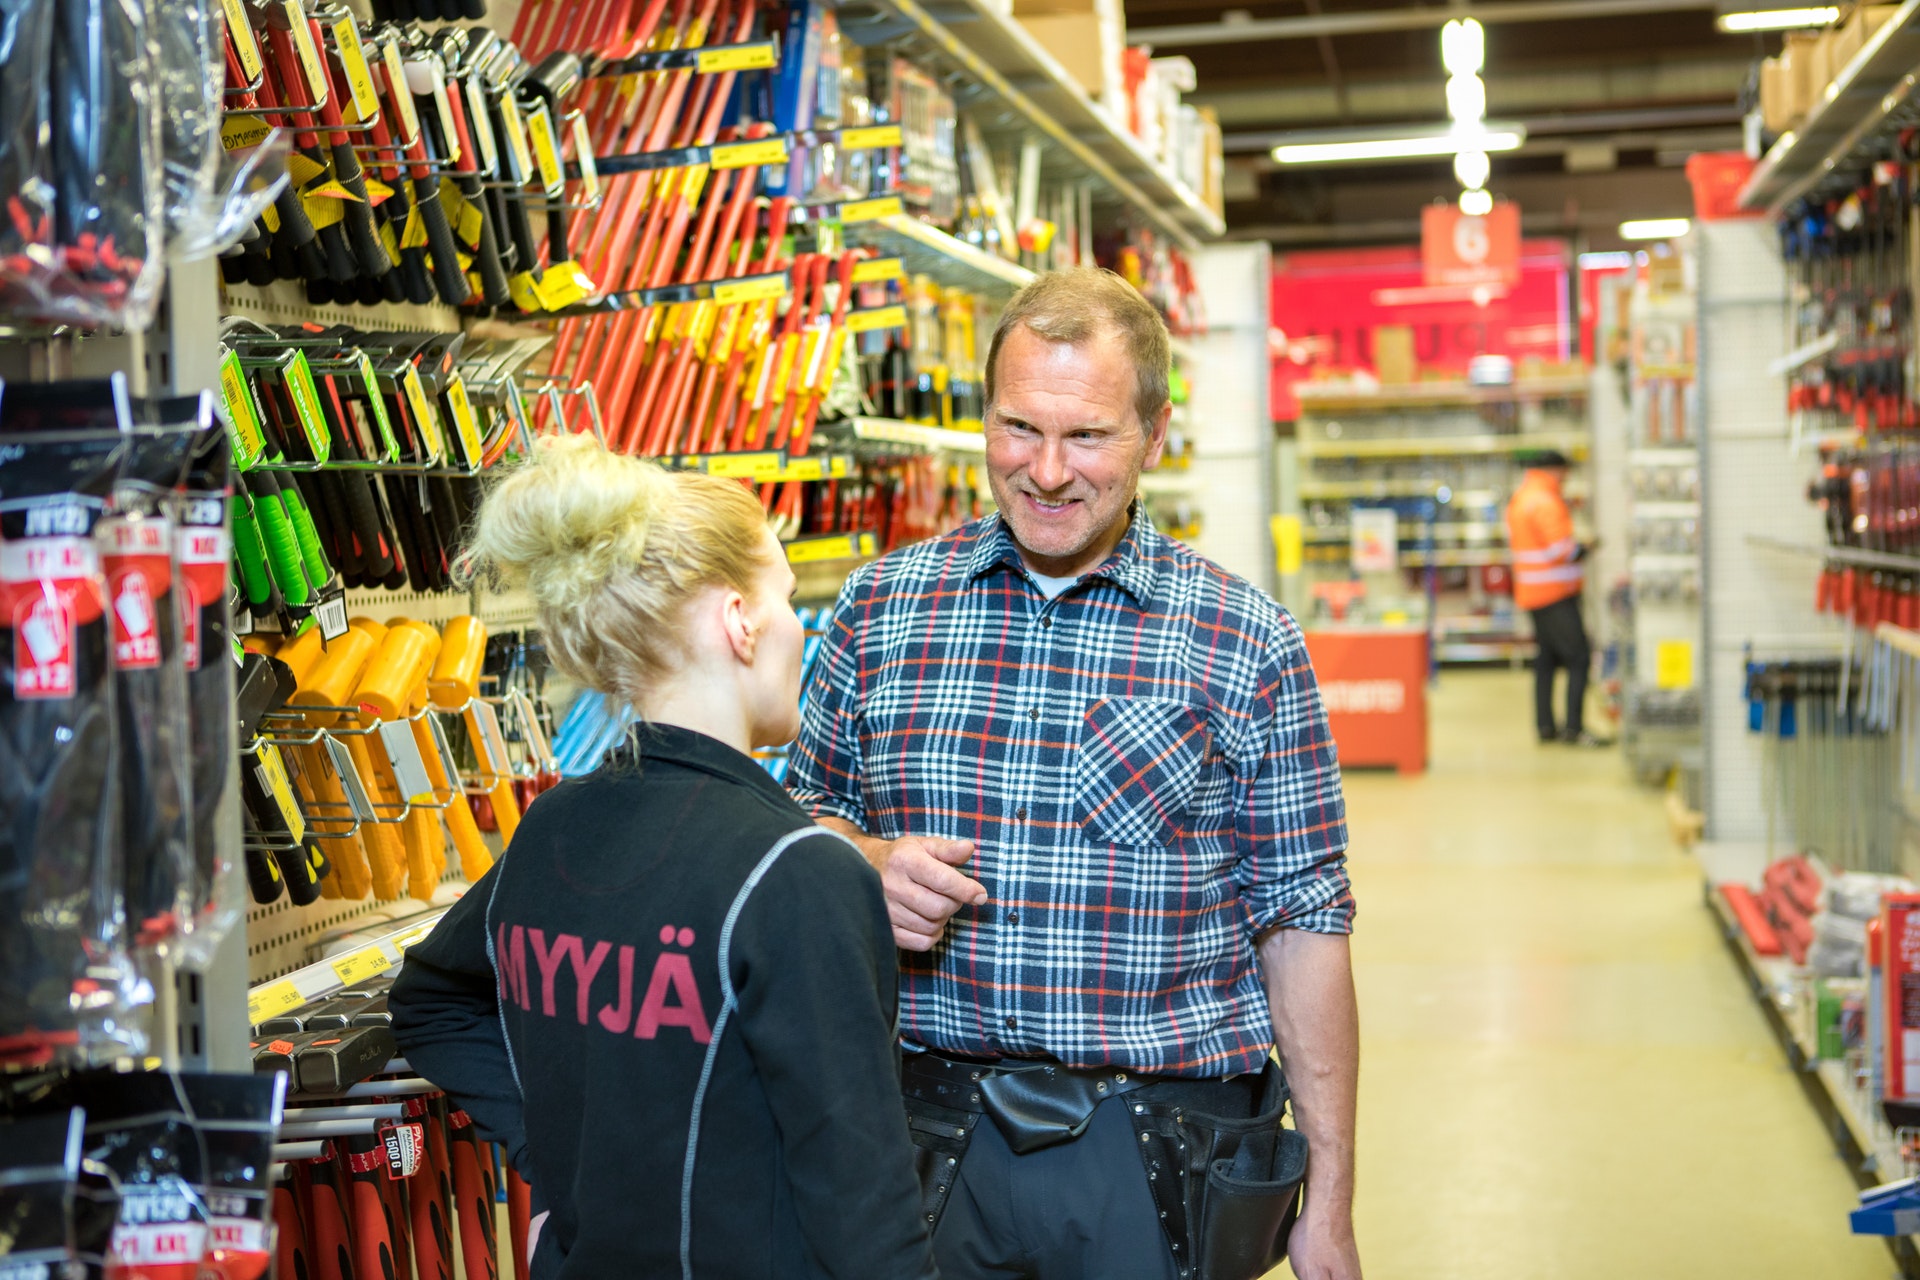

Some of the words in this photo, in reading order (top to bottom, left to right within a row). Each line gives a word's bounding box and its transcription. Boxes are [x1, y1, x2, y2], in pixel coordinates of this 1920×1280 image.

[250, 377, 267, 426] TOMBER
[293, 376, 325, 453] TOMBER
[498, 922, 713, 1045] MYYJÄ
[385, 1136, 401, 1160] 1500
[391, 1161, 402, 1169] G
[412, 1125, 423, 1174] PAJALA
